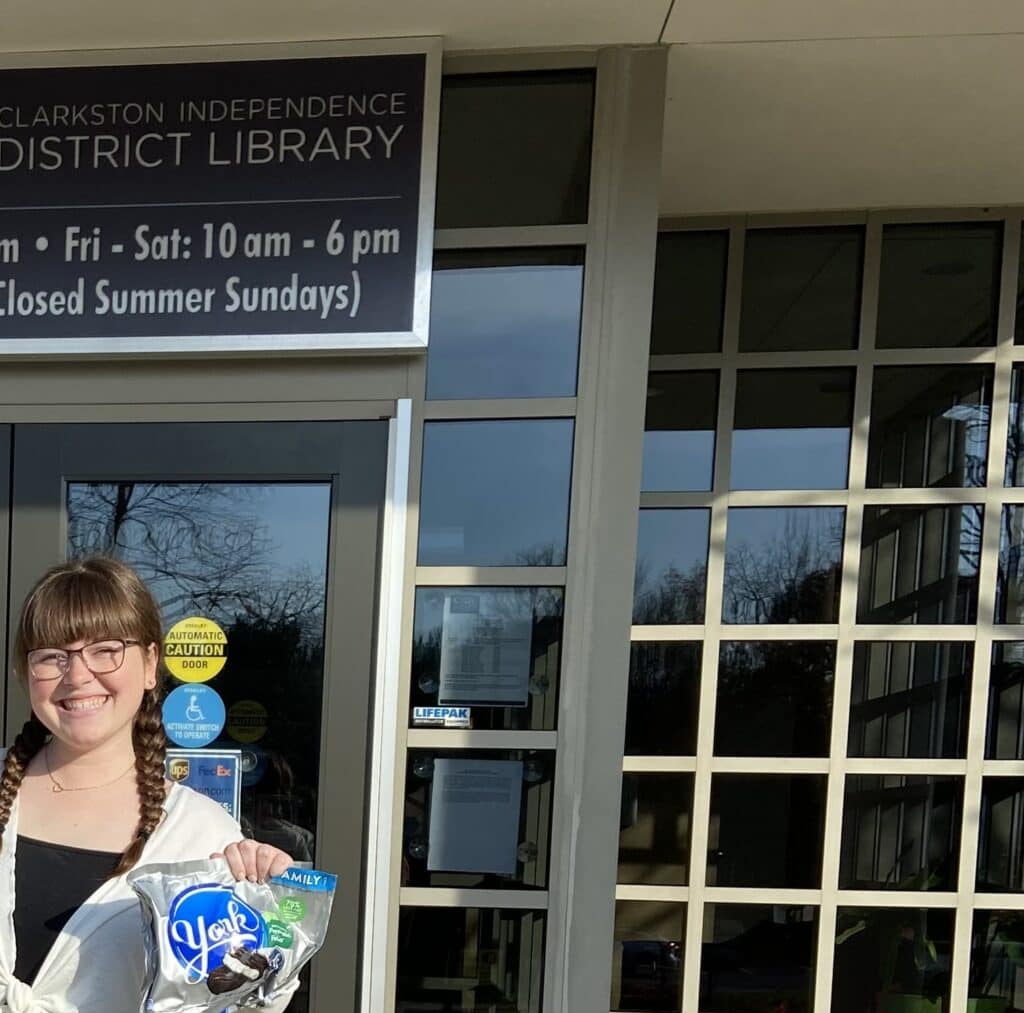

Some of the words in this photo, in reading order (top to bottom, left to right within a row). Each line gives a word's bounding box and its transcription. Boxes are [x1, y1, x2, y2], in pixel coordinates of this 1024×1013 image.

[180, 93, 407, 123] INDEPENDENCE
[208, 124, 404, 165] LIBRARY
[65, 226, 101, 262] Fri
[134, 224, 192, 261] Sat:
[202, 222, 237, 259] 10
[244, 230, 290, 257] am
[326, 219, 345, 255] 6
[352, 228, 400, 263] pm
[95, 279, 215, 316] Summer
[225, 270, 361, 319] Sundays)
[169, 631, 223, 640] AUTOMATIC
[166, 644, 224, 655] CAUTION
[182, 660, 208, 669] DOOR
[415, 708, 468, 718] LIFEPAK
[198, 764, 231, 776] FedEx
[280, 871, 322, 885] AMILY
[172, 900, 259, 984] York
